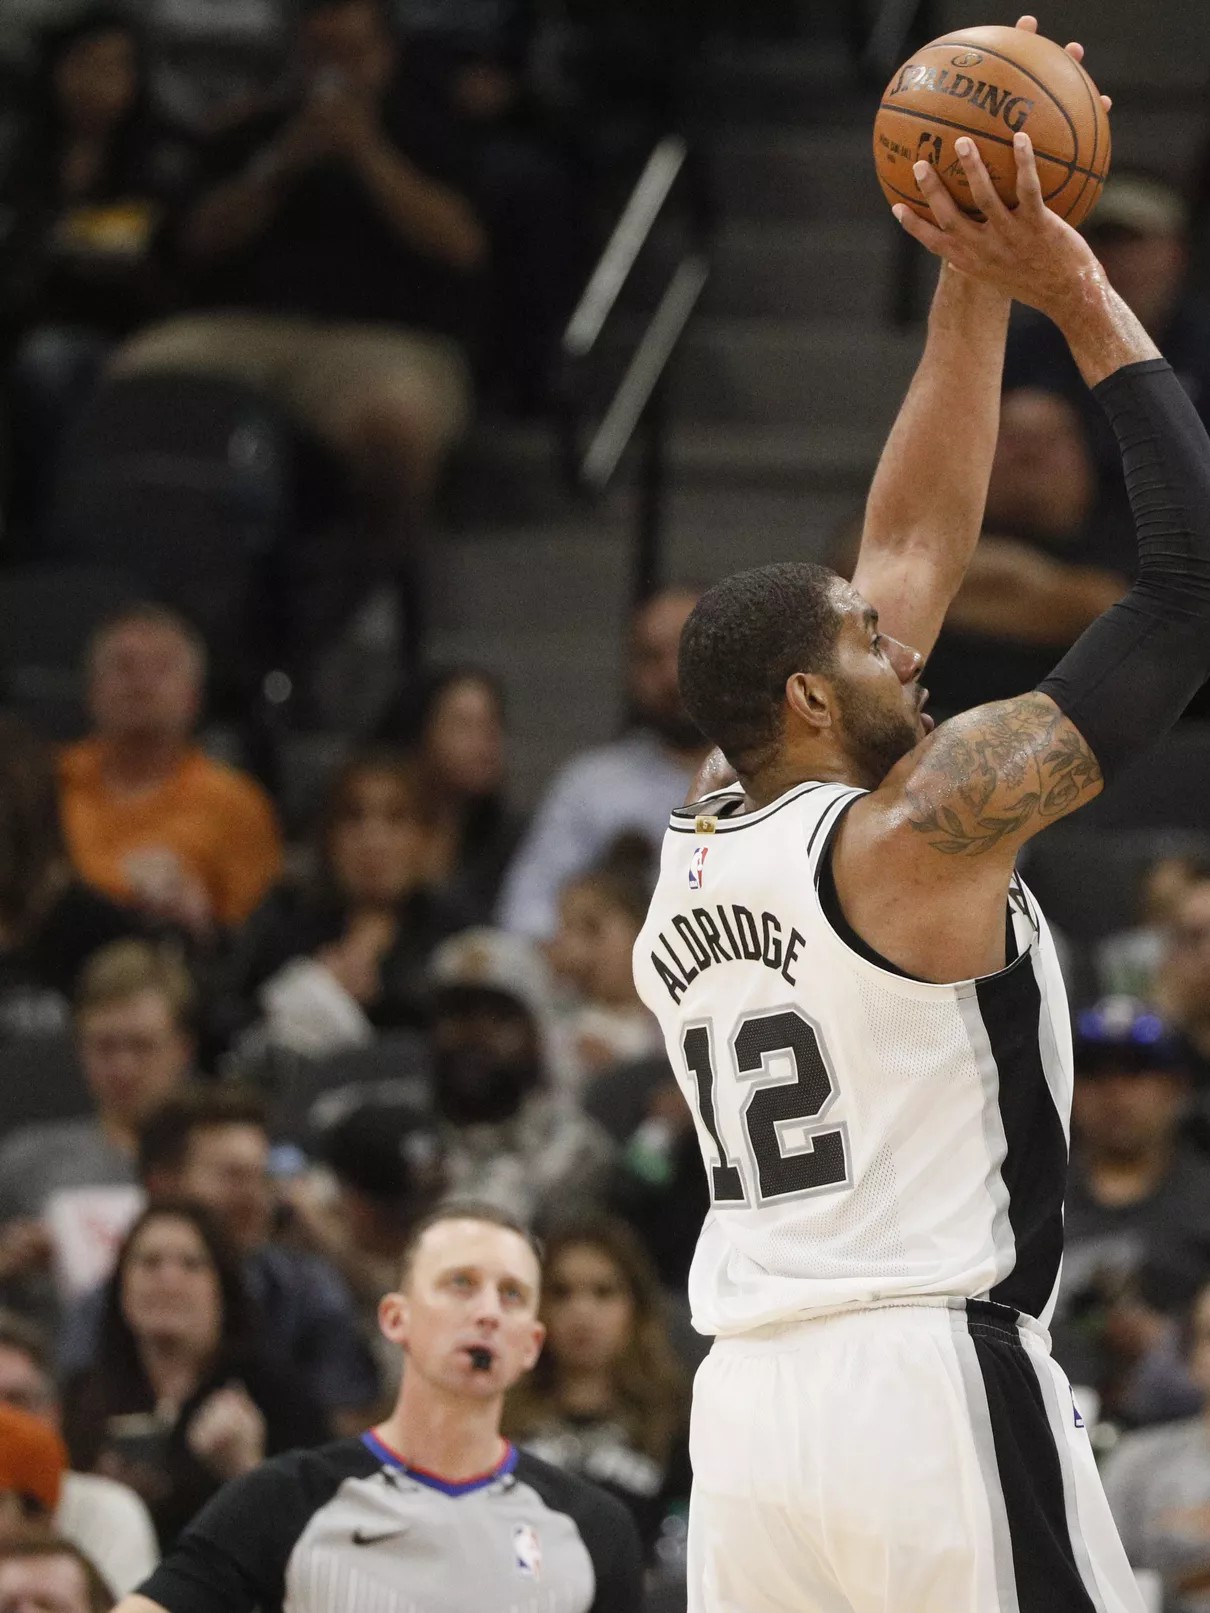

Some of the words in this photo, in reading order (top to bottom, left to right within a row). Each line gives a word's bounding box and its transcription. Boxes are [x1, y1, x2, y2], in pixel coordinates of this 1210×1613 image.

[890, 64, 1034, 132] SPALDING
[651, 904, 806, 1005] ALDRIDGE
[680, 1002, 854, 1209] 12
